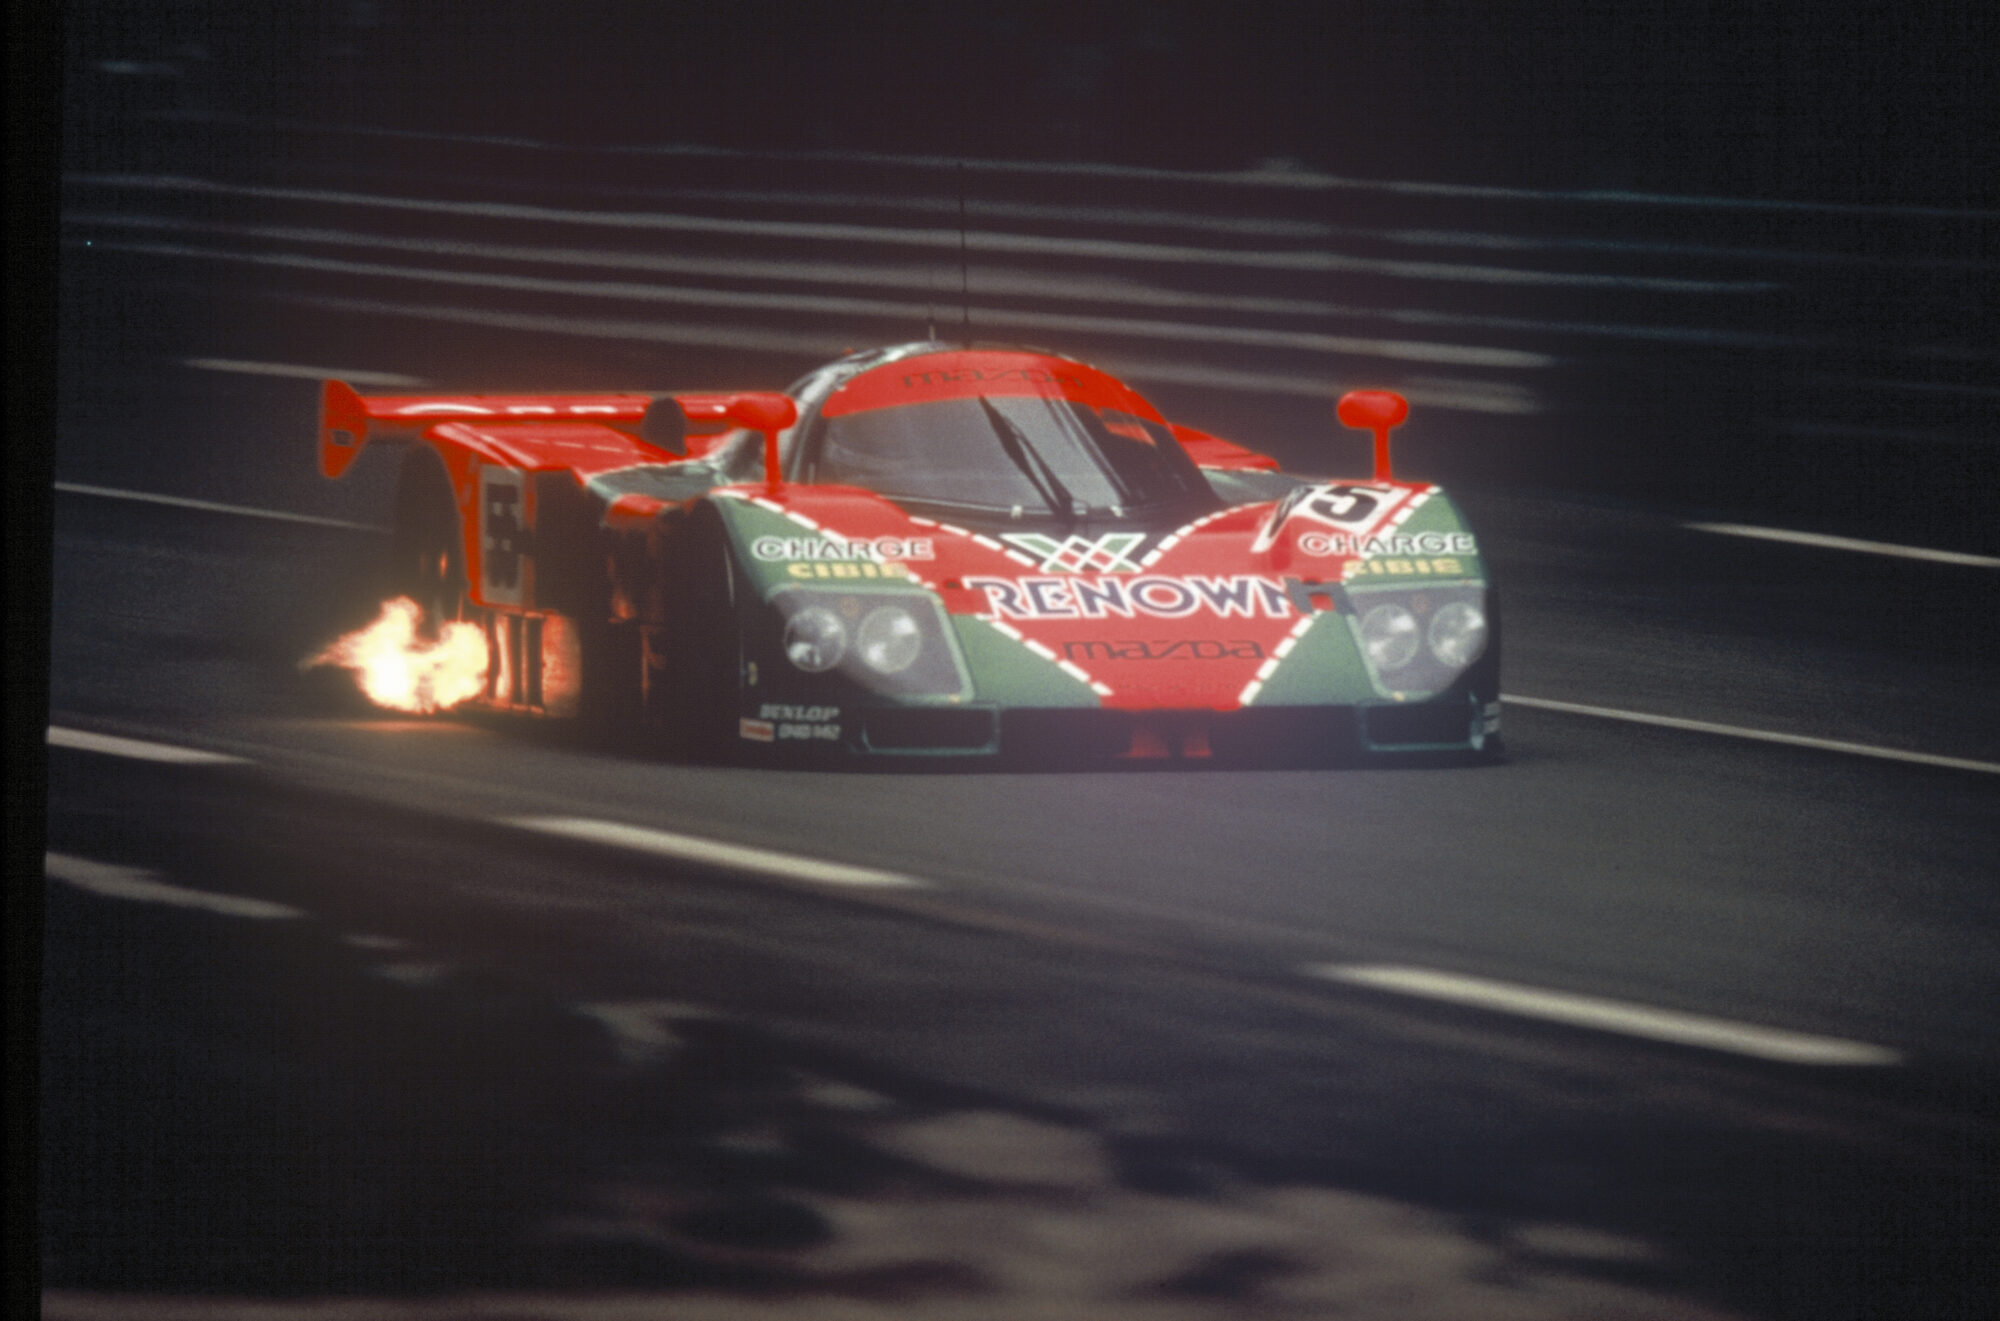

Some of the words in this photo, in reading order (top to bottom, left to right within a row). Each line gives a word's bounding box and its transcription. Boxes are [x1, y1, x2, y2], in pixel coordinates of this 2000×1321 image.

[752, 534, 936, 561] CHARGE
[1298, 532, 1478, 556] CHARGE
[787, 562, 908, 579] CIBIE
[1343, 557, 1463, 575] CIBIE
[1062, 639, 1266, 661] mazda
